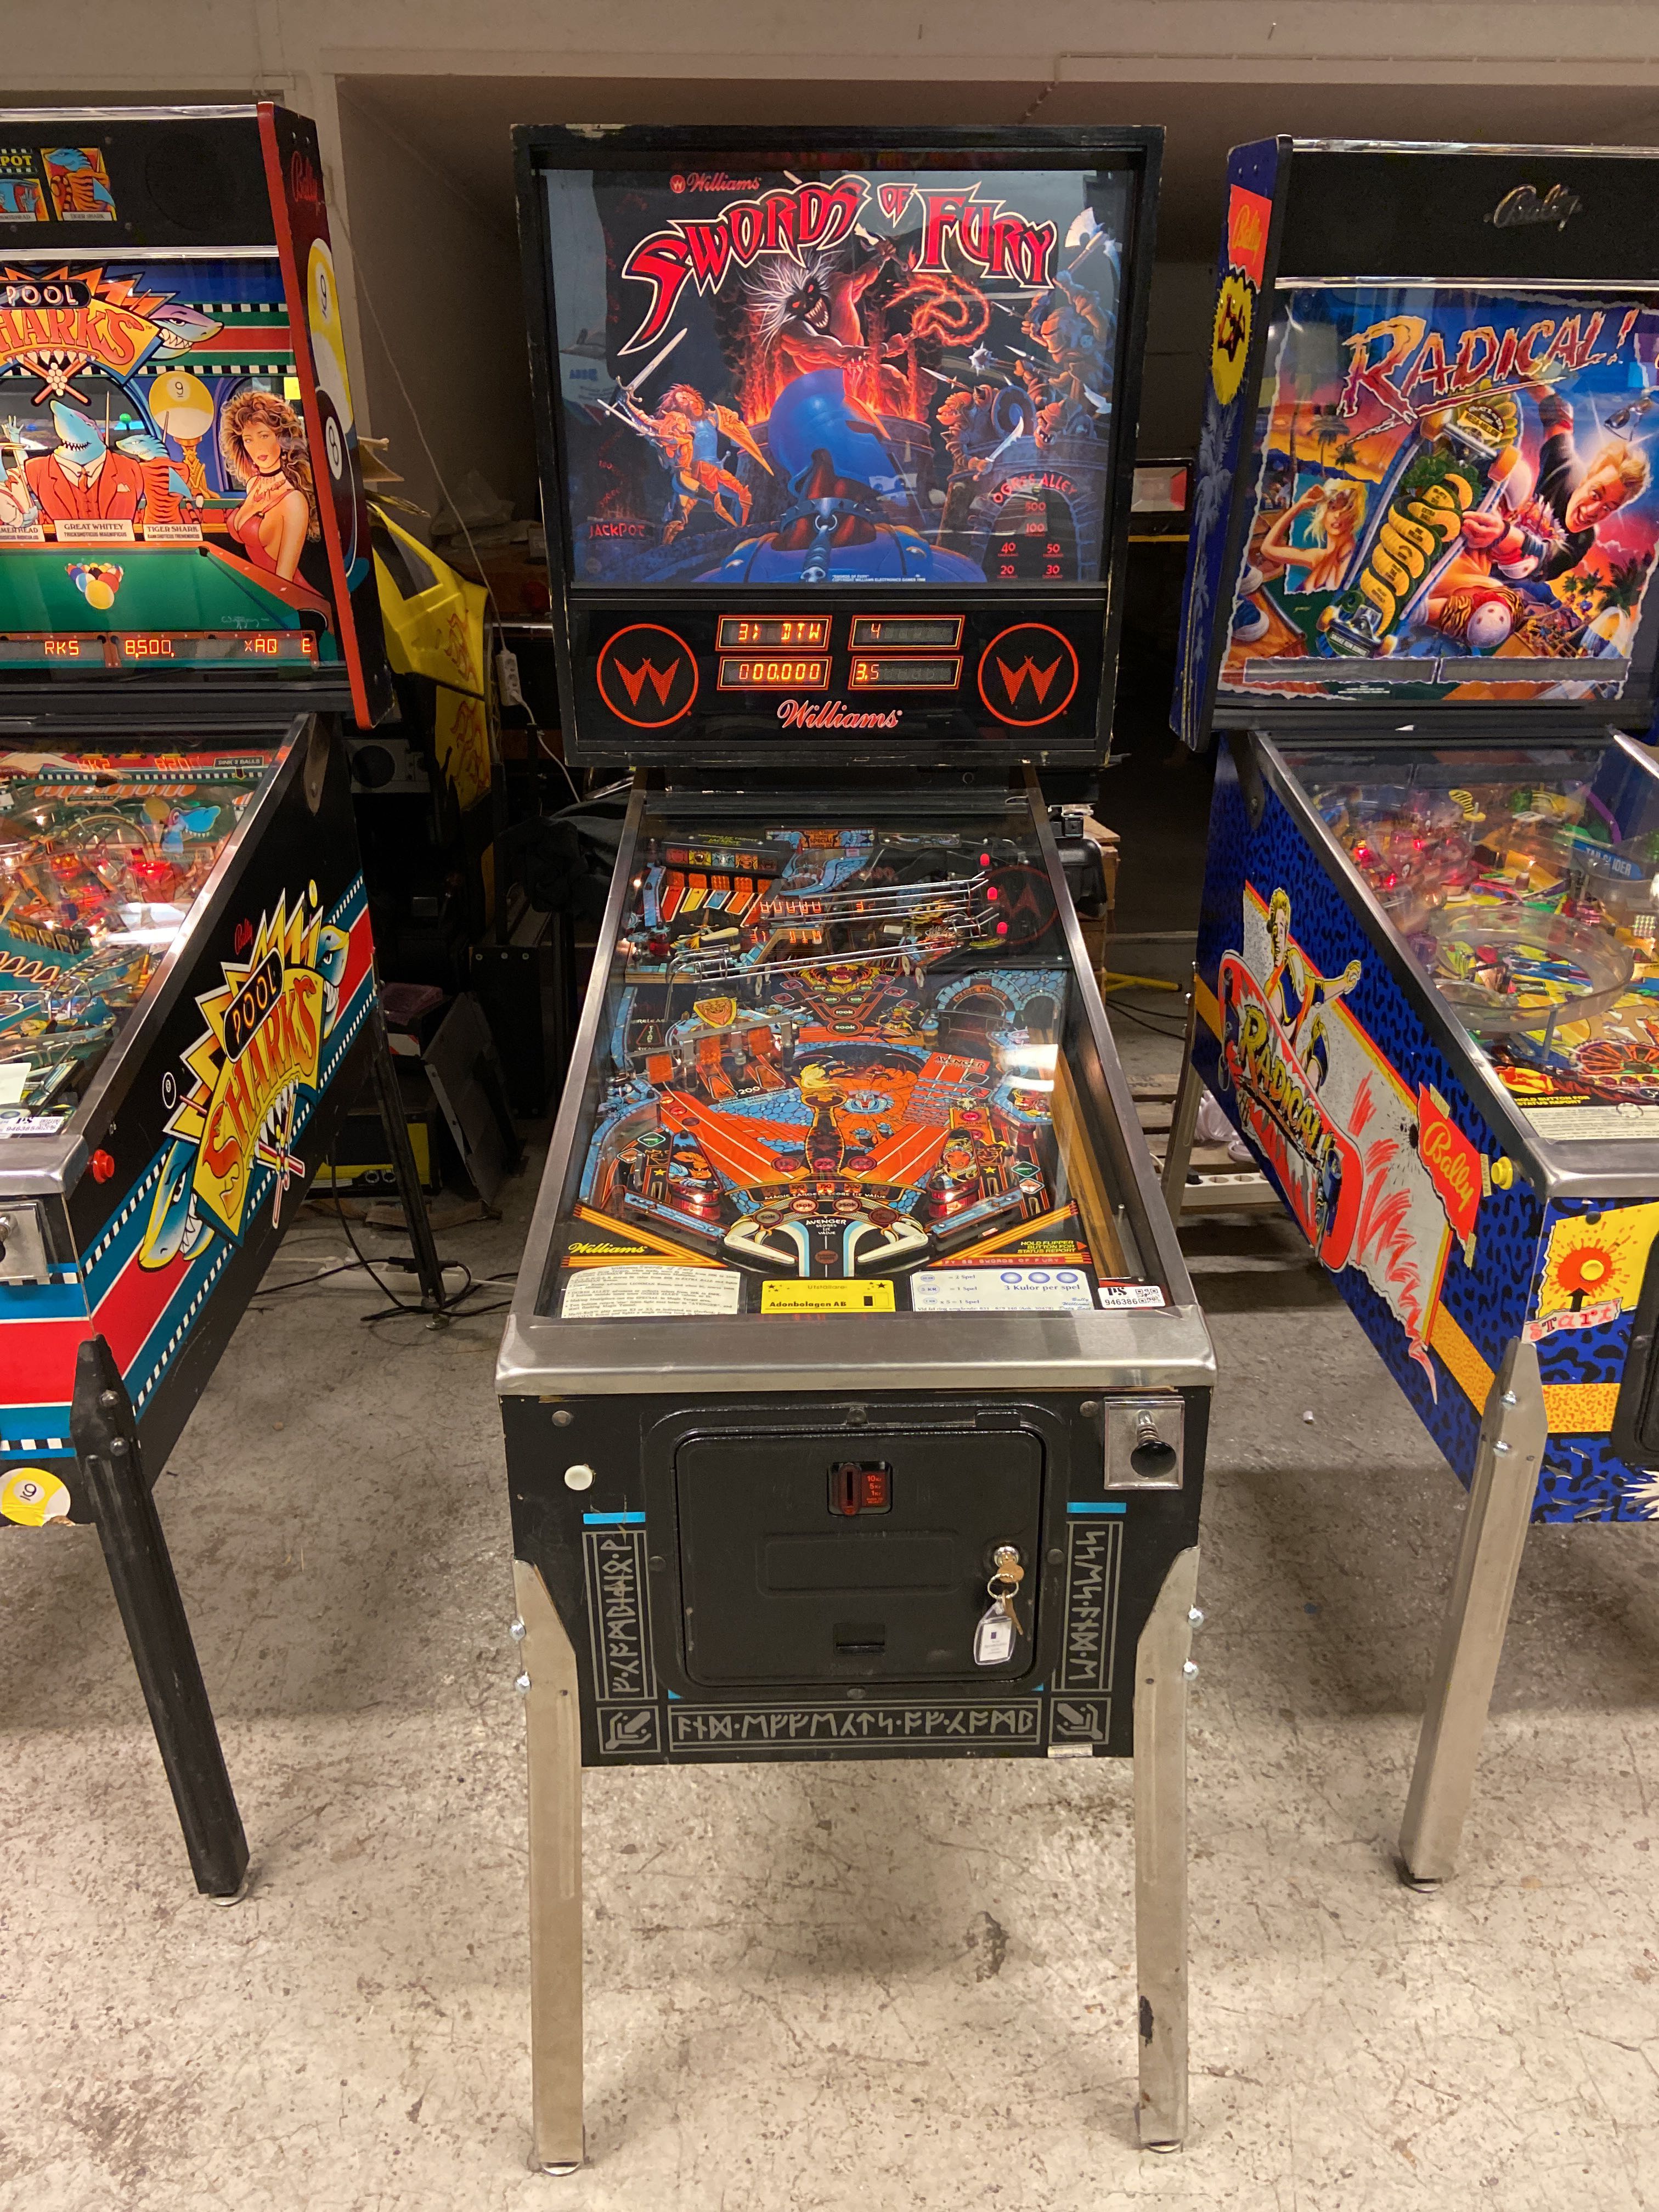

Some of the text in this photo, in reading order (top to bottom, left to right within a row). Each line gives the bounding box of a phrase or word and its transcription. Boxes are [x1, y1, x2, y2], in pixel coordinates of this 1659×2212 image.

[0, 156, 32, 166] POT
[687, 172, 761, 193] Williams
[620, 174, 1054, 356] SWORDS OF FURY
[6, 284, 78, 306] POOL
[0, 308, 145, 365] HARKS
[1337, 308, 1639, 423] RADICAL!
[174, 381, 184, 395] 9
[1040, 473, 1077, 495] ALLEY
[589, 523, 646, 539] JACKPOT
[1026, 523, 1045, 533] 100
[1001, 543, 1060, 554] 40 50
[1000, 565, 1060, 574] 20 30
[781, 623, 821, 641] DTW
[44, 640, 78, 656] RKS
[777, 699, 901, 729] Williams
[232, 962, 278, 1045] POOL
[934, 1056, 985, 1069] AVENGER
[204, 976, 317, 1218] SHARKS
[738, 1086, 761, 1094] 200
[1423, 1122, 1475, 1212] Bally
[568, 1242, 646, 1254] Williams
